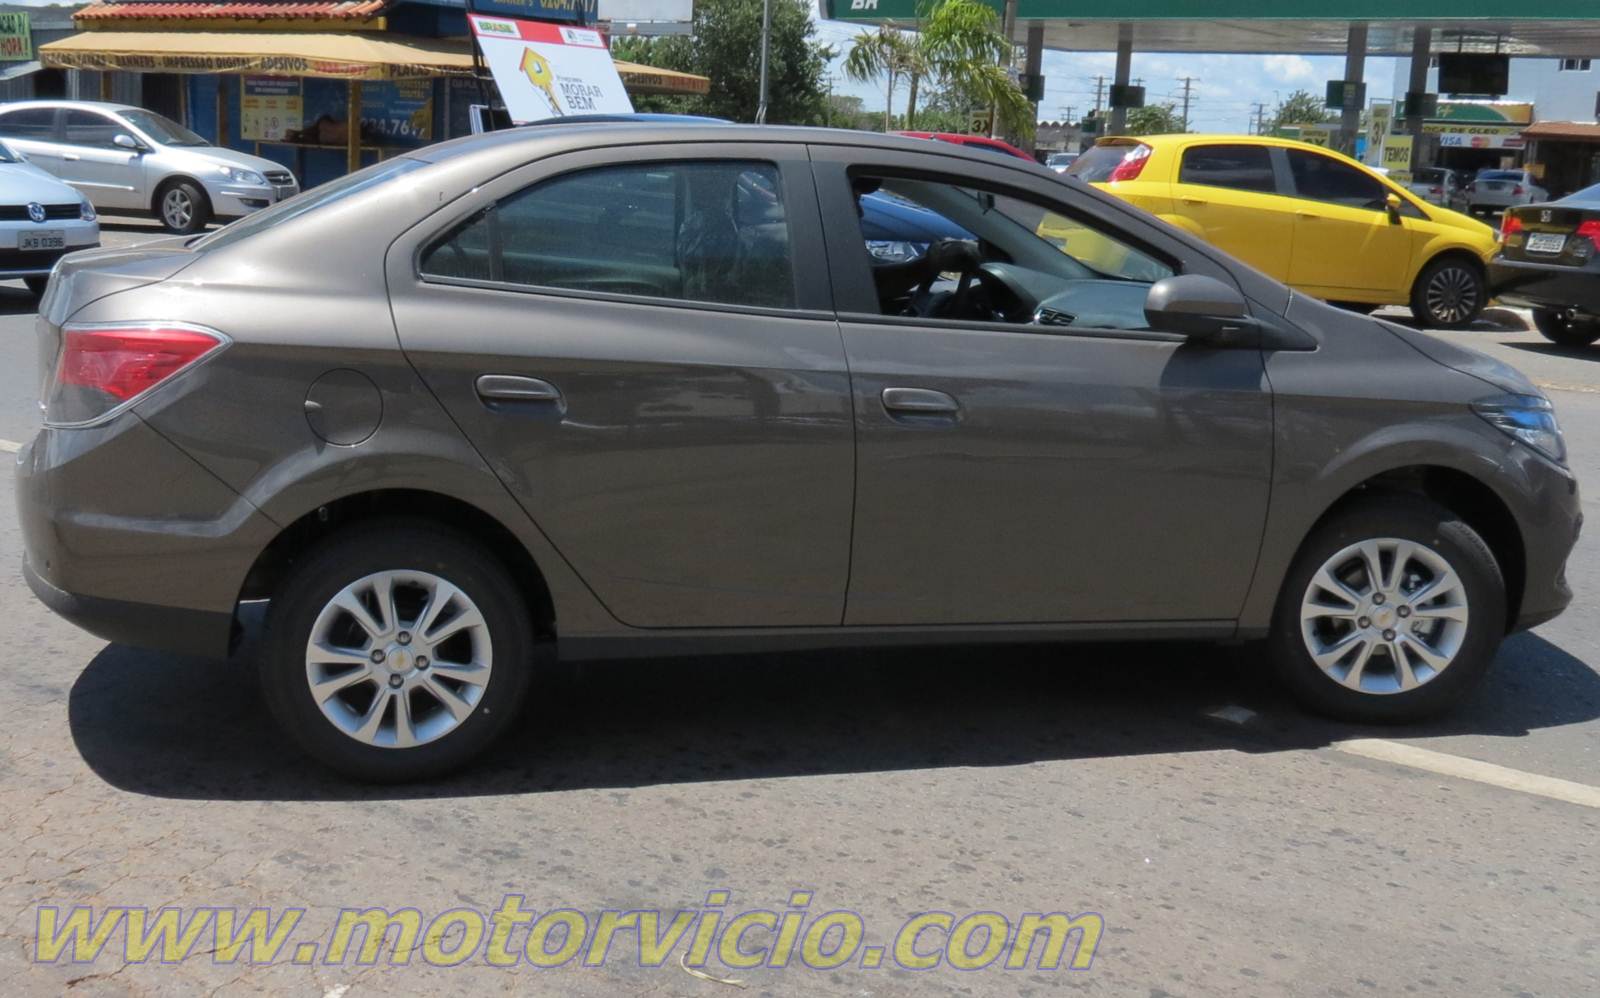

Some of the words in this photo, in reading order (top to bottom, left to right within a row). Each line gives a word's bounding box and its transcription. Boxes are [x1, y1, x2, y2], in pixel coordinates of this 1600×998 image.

[215, 56, 251, 70] DIGITAL
[260, 57, 308, 71] ADESIVOS
[560, 83, 604, 98] MORAR
[566, 96, 597, 110] BEM
[1440, 136, 1462, 146] VISA
